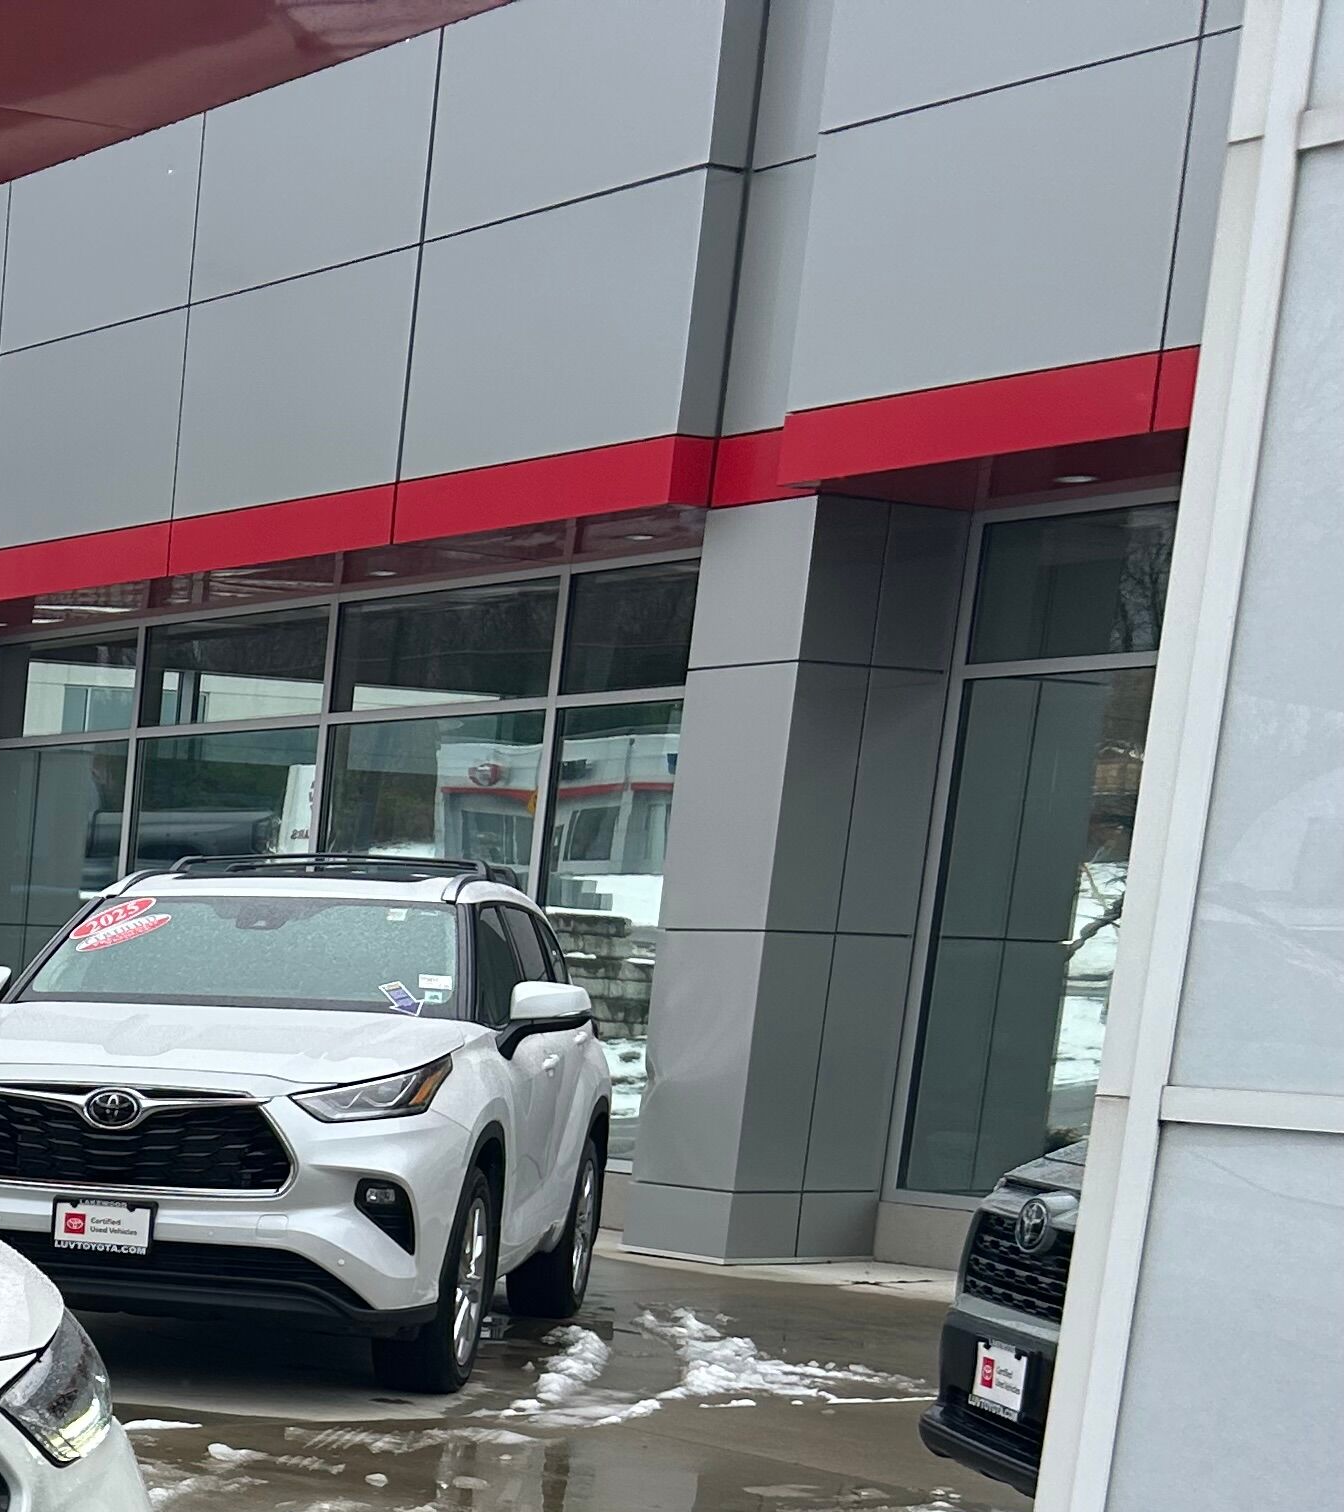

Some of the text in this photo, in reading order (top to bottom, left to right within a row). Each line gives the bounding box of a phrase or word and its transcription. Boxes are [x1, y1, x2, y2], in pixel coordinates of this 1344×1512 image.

[90, 903, 140, 933] 2025
[90, 1217, 122, 1226] Certified
[89, 1226, 108, 1234] Used
[54, 1240, 147, 1255] LUVTOYOTA.COM
